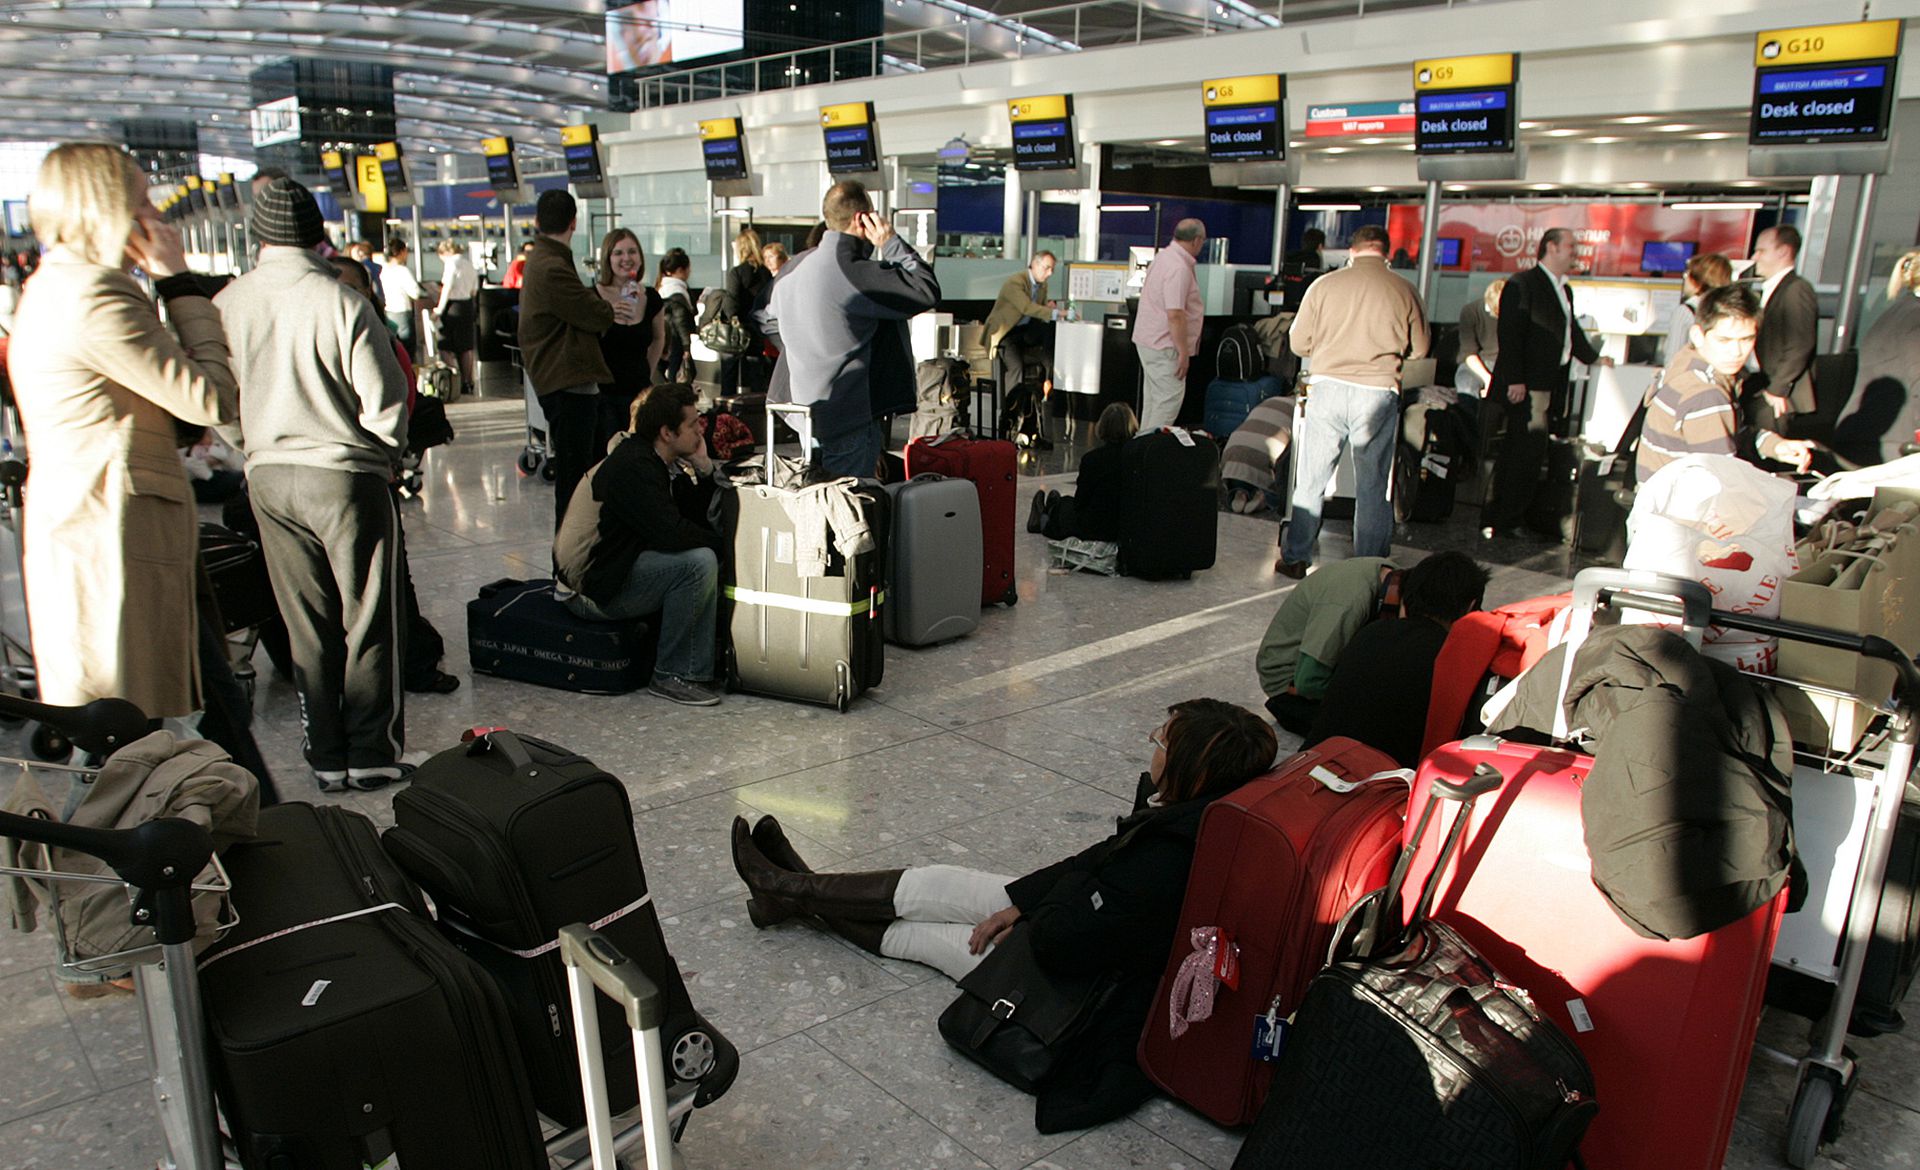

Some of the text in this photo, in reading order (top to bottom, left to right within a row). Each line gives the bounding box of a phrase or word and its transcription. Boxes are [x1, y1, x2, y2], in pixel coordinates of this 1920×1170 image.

[1787, 37, 1824, 54] G10
[1436, 67, 1454, 79] G9
[1219, 86, 1234, 97] G8
[1311, 108, 1347, 119] Customs
[1760, 98, 1855, 118] Desk closed
[1421, 117, 1488, 133] Desk closed
[1210, 130, 1262, 144] Desk closed
[1016, 142, 1056, 154] Desk closed
[366, 165, 376, 182] E
[1731, 575, 1778, 614] SALE
[503, 642, 527, 655] JAPAN
[533, 649, 563, 662] OMEGA
[567, 656, 594, 668] JAPAN
